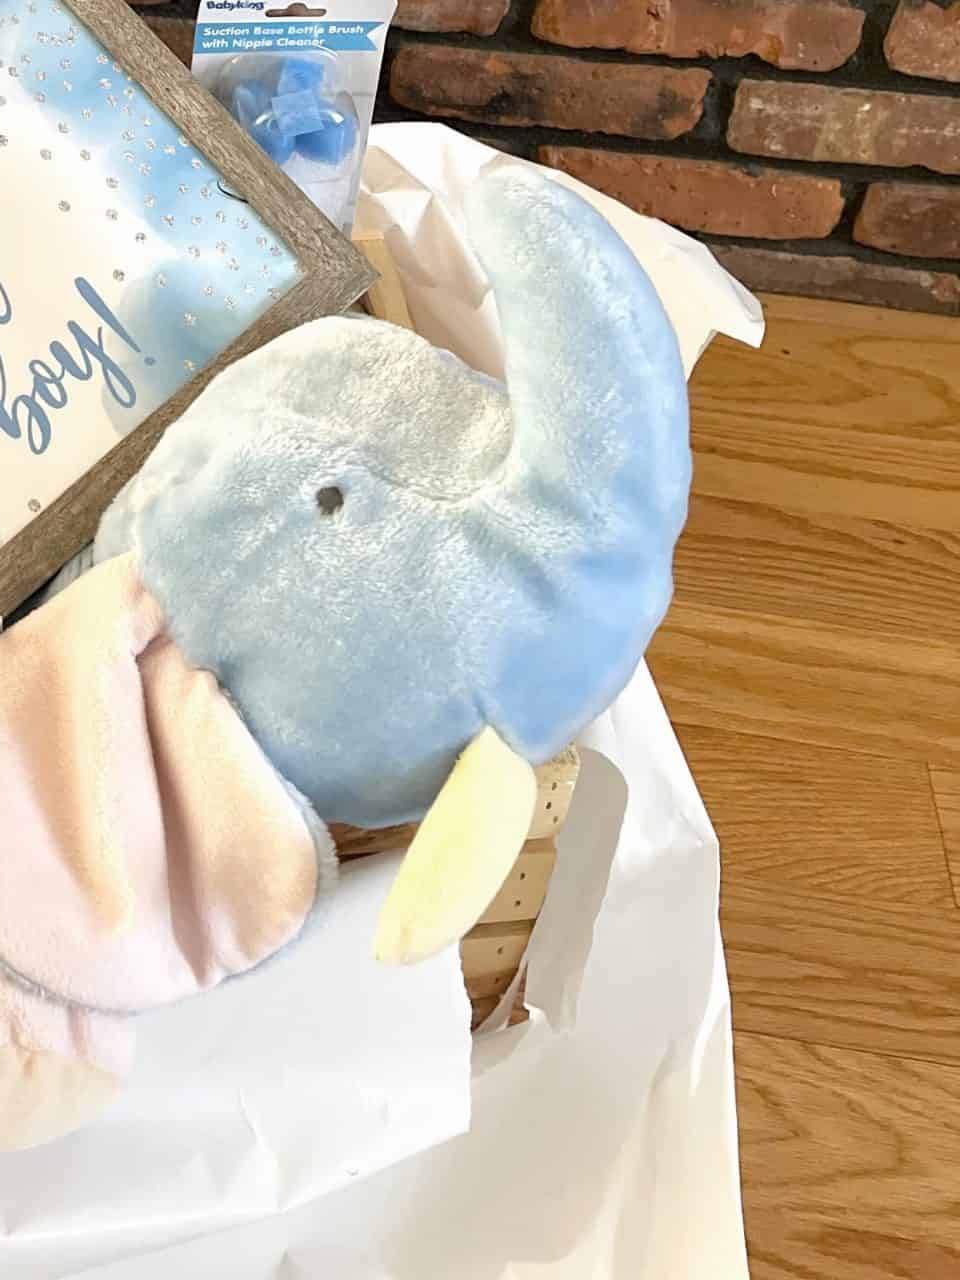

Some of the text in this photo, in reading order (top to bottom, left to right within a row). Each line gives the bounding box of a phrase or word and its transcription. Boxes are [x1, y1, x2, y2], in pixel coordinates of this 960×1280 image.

[203, 25, 365, 36] Suction Base Bottle Brush
[202, 37, 326, 50] with Nipple Cleaner
